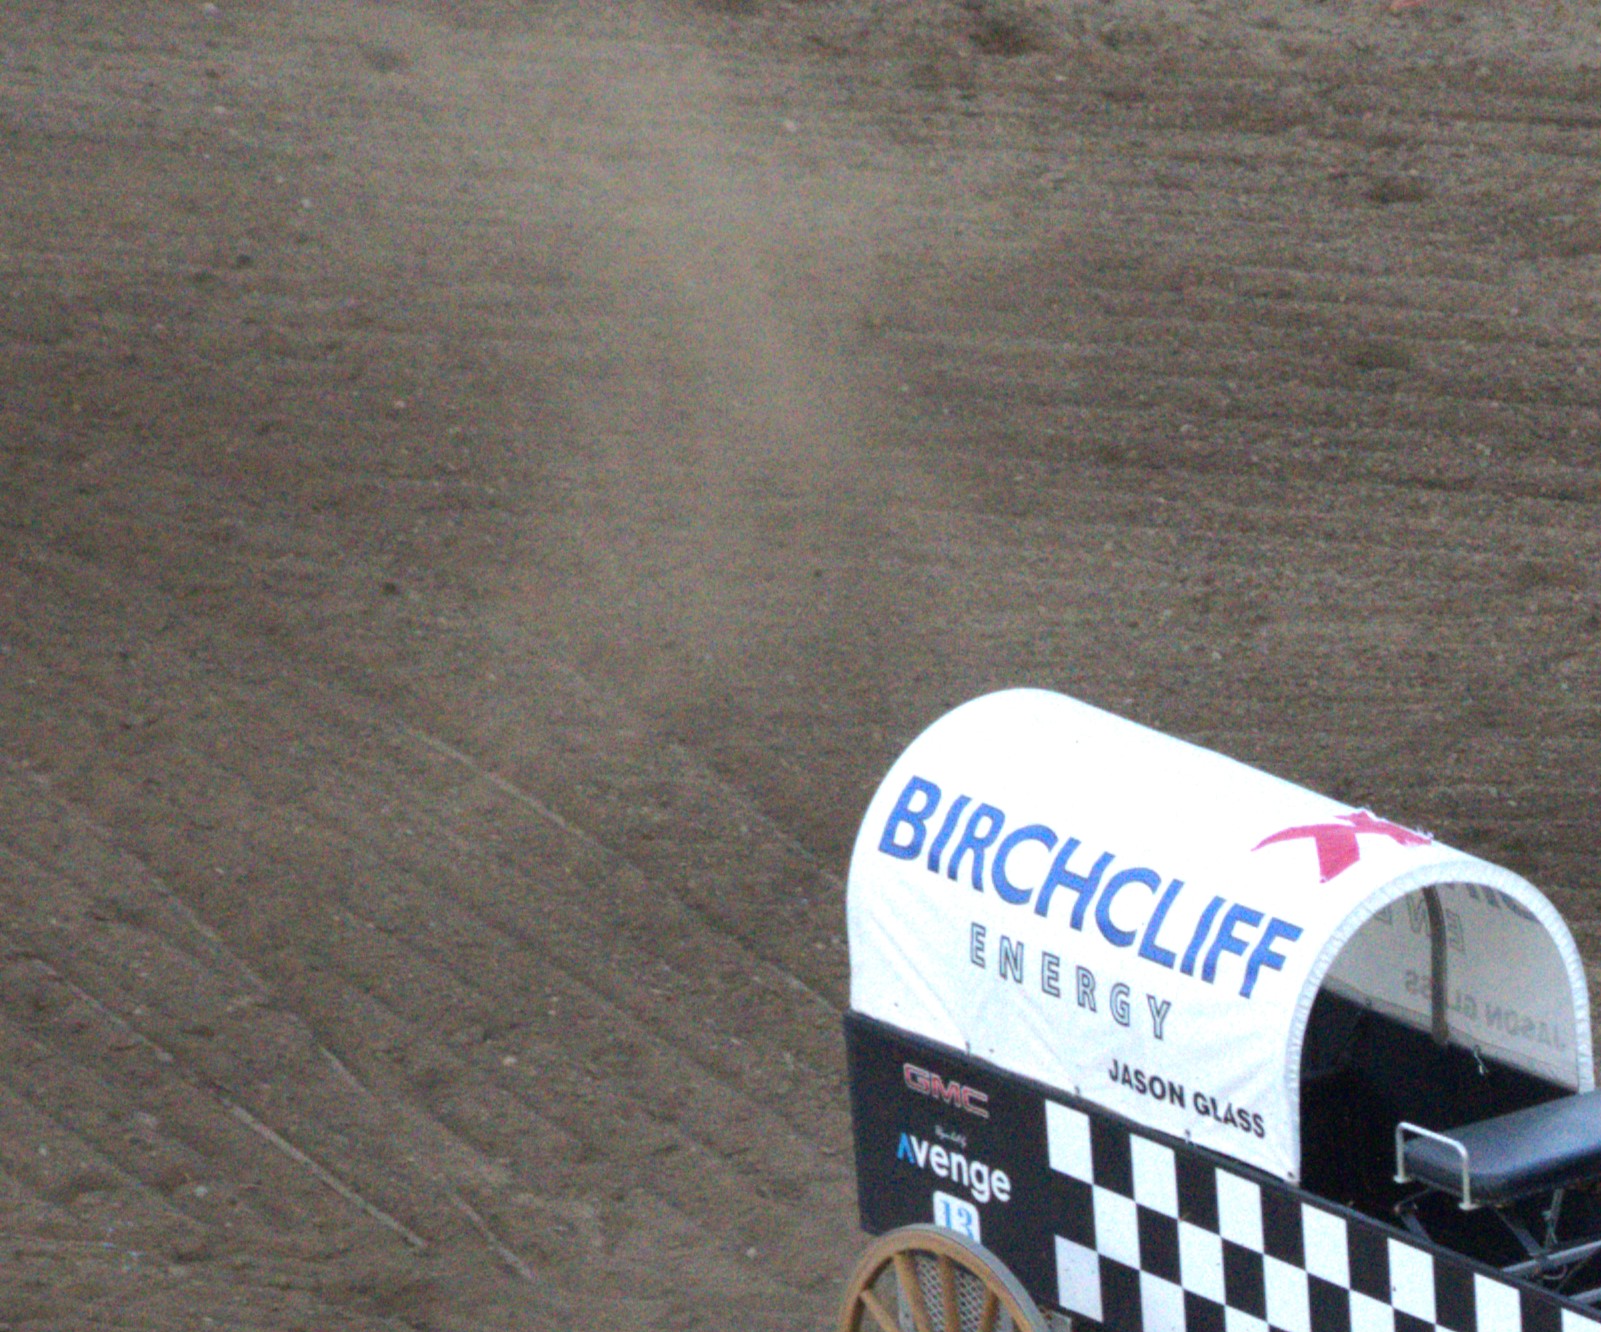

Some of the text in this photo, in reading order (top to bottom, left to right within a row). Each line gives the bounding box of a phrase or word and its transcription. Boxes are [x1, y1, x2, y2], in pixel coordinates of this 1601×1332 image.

[878, 775, 1304, 999] BIRCHCLIFF
[970, 922, 1171, 1040] ENERGY
[903, 1062, 990, 1119] GMC
[1108, 1058, 1265, 1139] JASON GLASS
